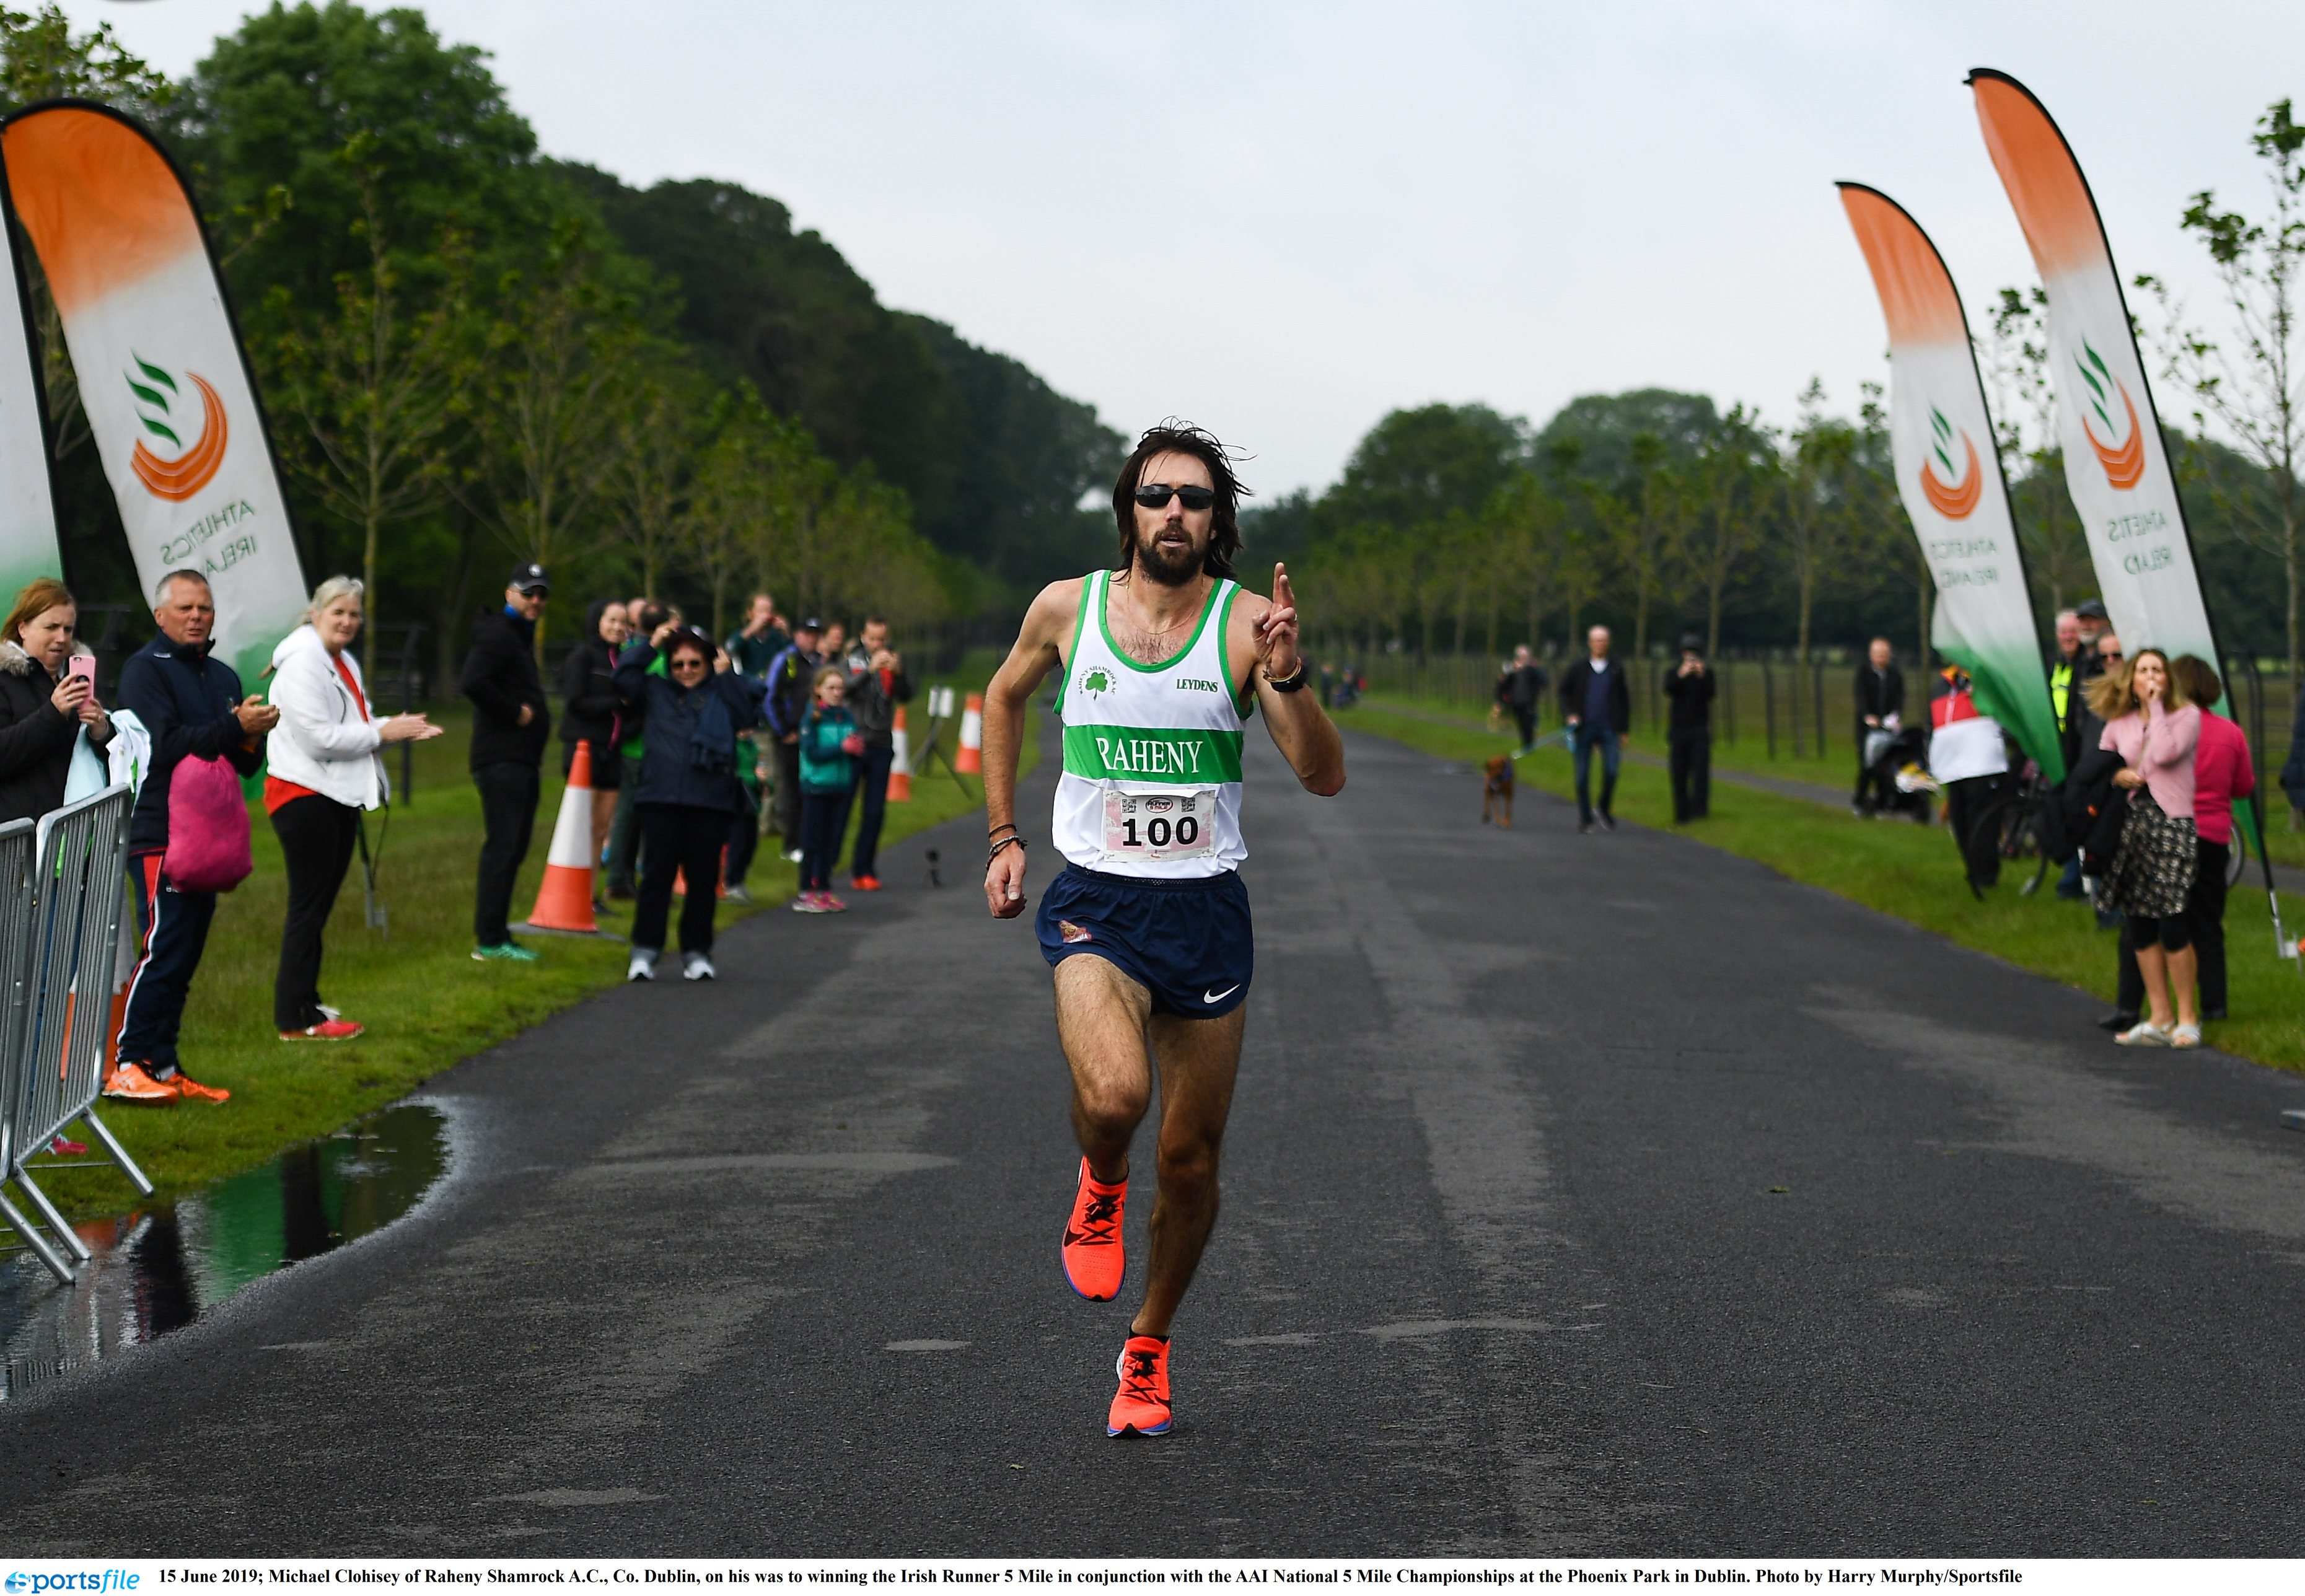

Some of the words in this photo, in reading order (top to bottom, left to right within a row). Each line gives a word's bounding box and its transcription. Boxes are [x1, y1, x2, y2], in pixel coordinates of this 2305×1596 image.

[1176, 678, 1218, 693] LEYDENS
[1095, 737, 1203, 774] RAHENY
[1122, 816, 1198, 846] 100
